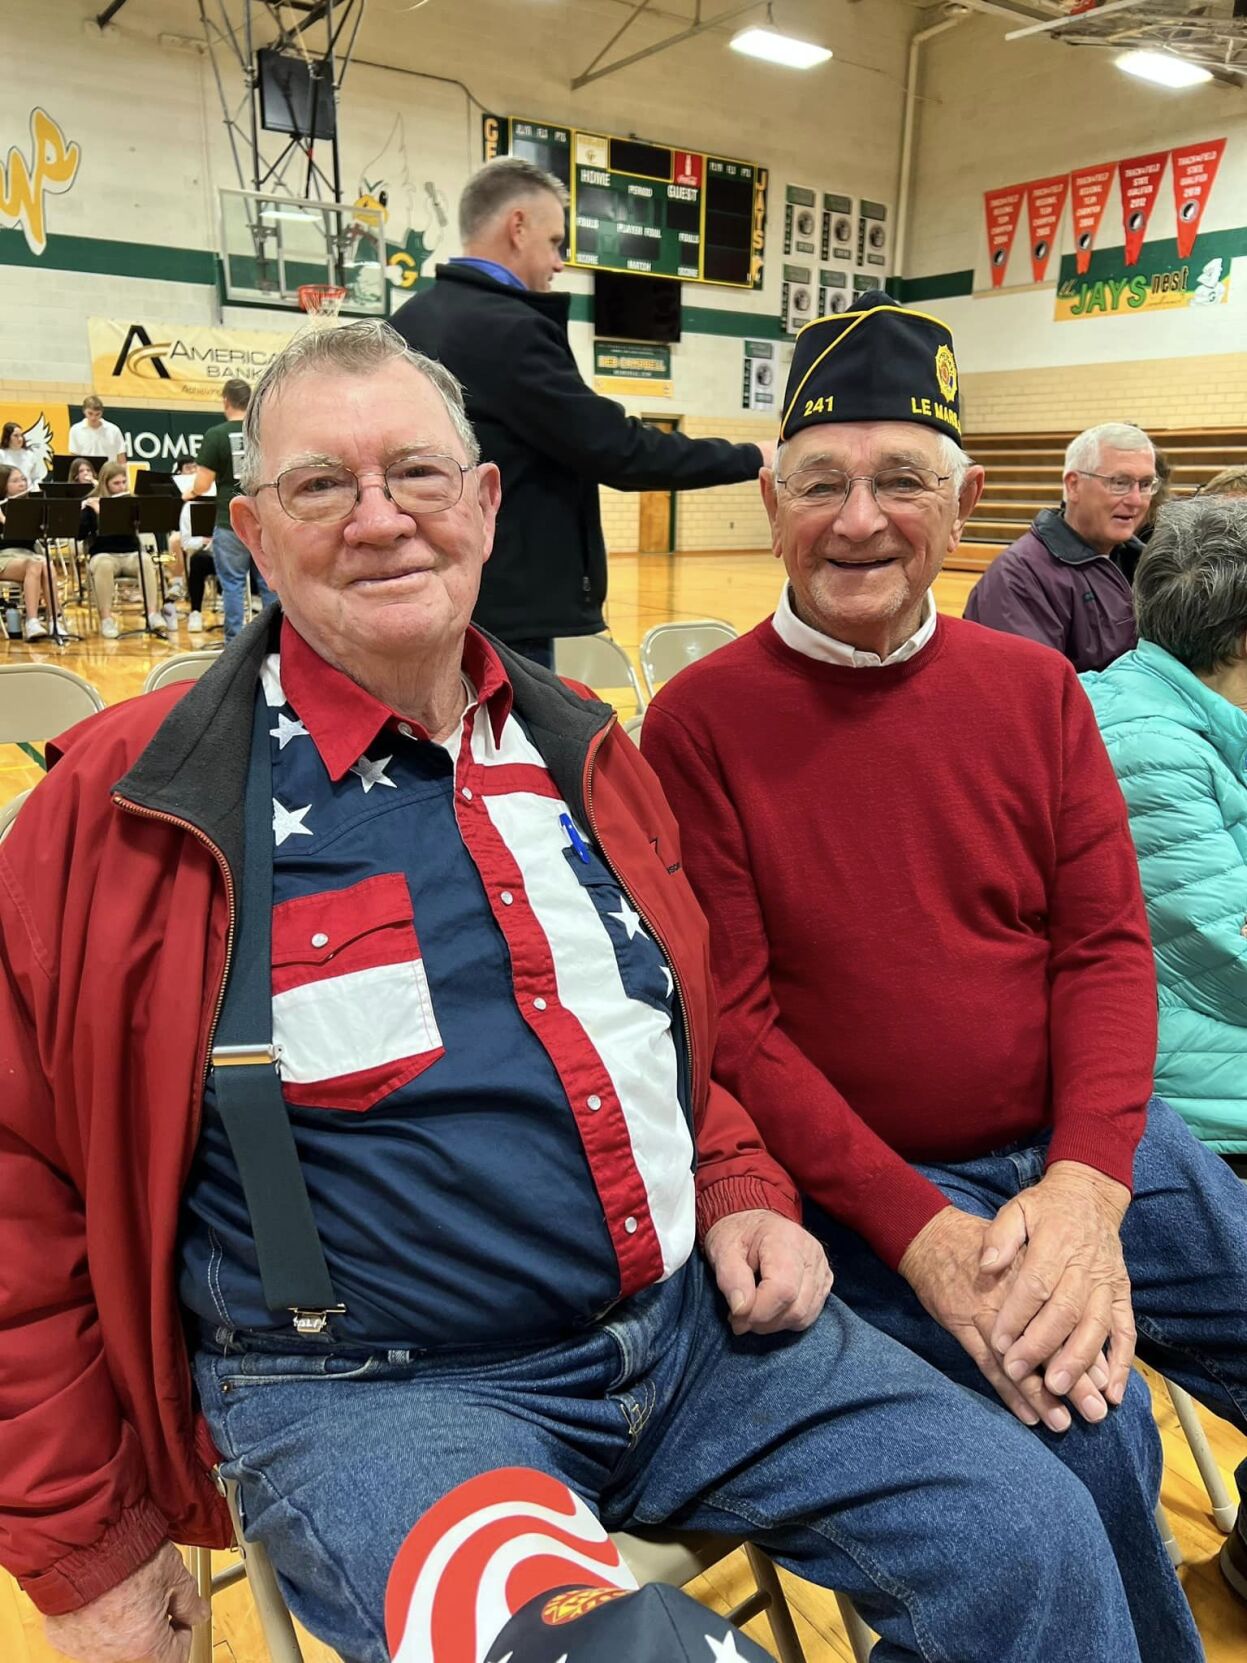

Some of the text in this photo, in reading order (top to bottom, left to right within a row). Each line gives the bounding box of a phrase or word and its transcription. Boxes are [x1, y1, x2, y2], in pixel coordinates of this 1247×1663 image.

[580, 169, 611, 187] HOME
[667, 184, 698, 202] GUEST
[1070, 275, 1147, 316] JAYS
[1151, 264, 1189, 294] nest
[207, 365, 263, 379] BANK
[803, 396, 834, 417] 241
[911, 397, 932, 416] LE
[123, 431, 204, 459] HOME
